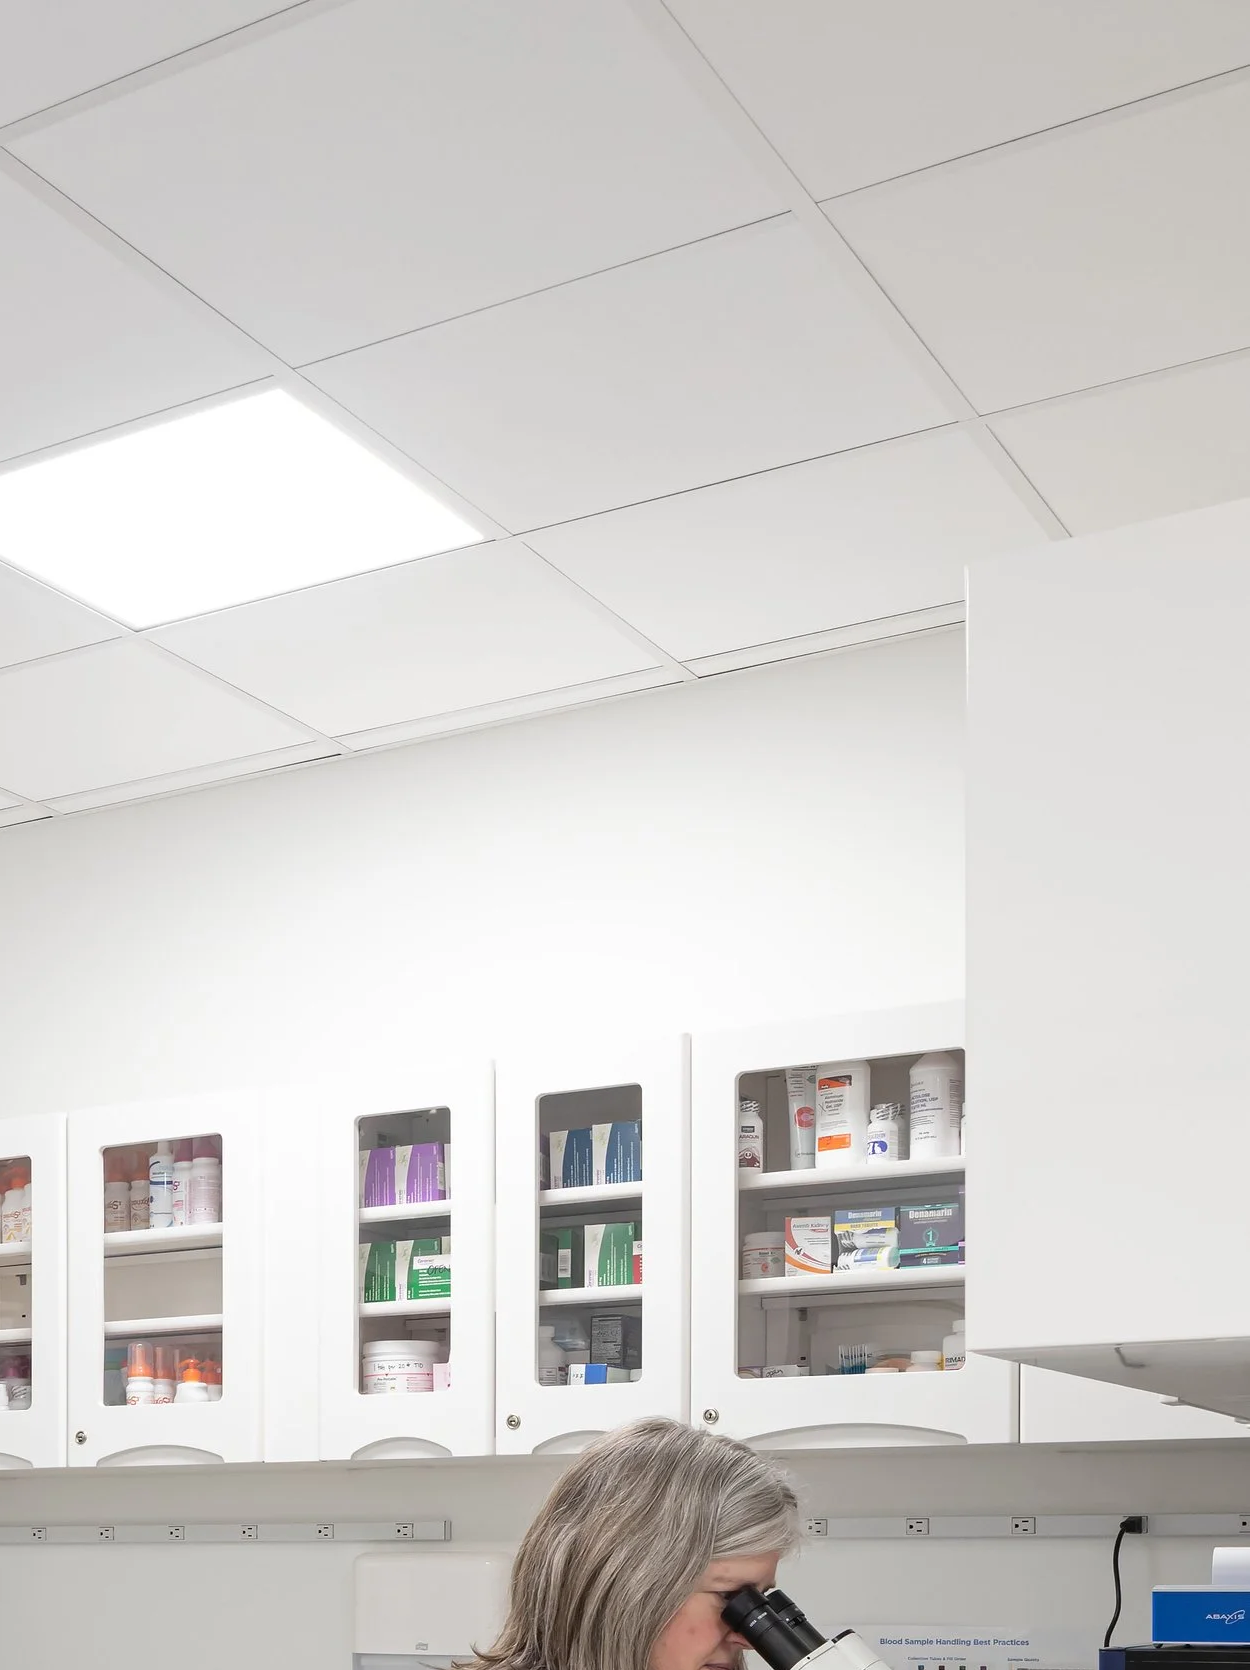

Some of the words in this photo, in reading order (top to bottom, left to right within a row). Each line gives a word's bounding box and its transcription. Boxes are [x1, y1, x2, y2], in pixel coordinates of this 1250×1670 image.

[908, 1209, 953, 1220] Denamarin
[1205, 1611, 1245, 1622] ABAXIS
[904, 1638, 934, 1647] Sample
[935, 1638, 972, 1647] Handling
[993, 1639, 1030, 1647] Practices
